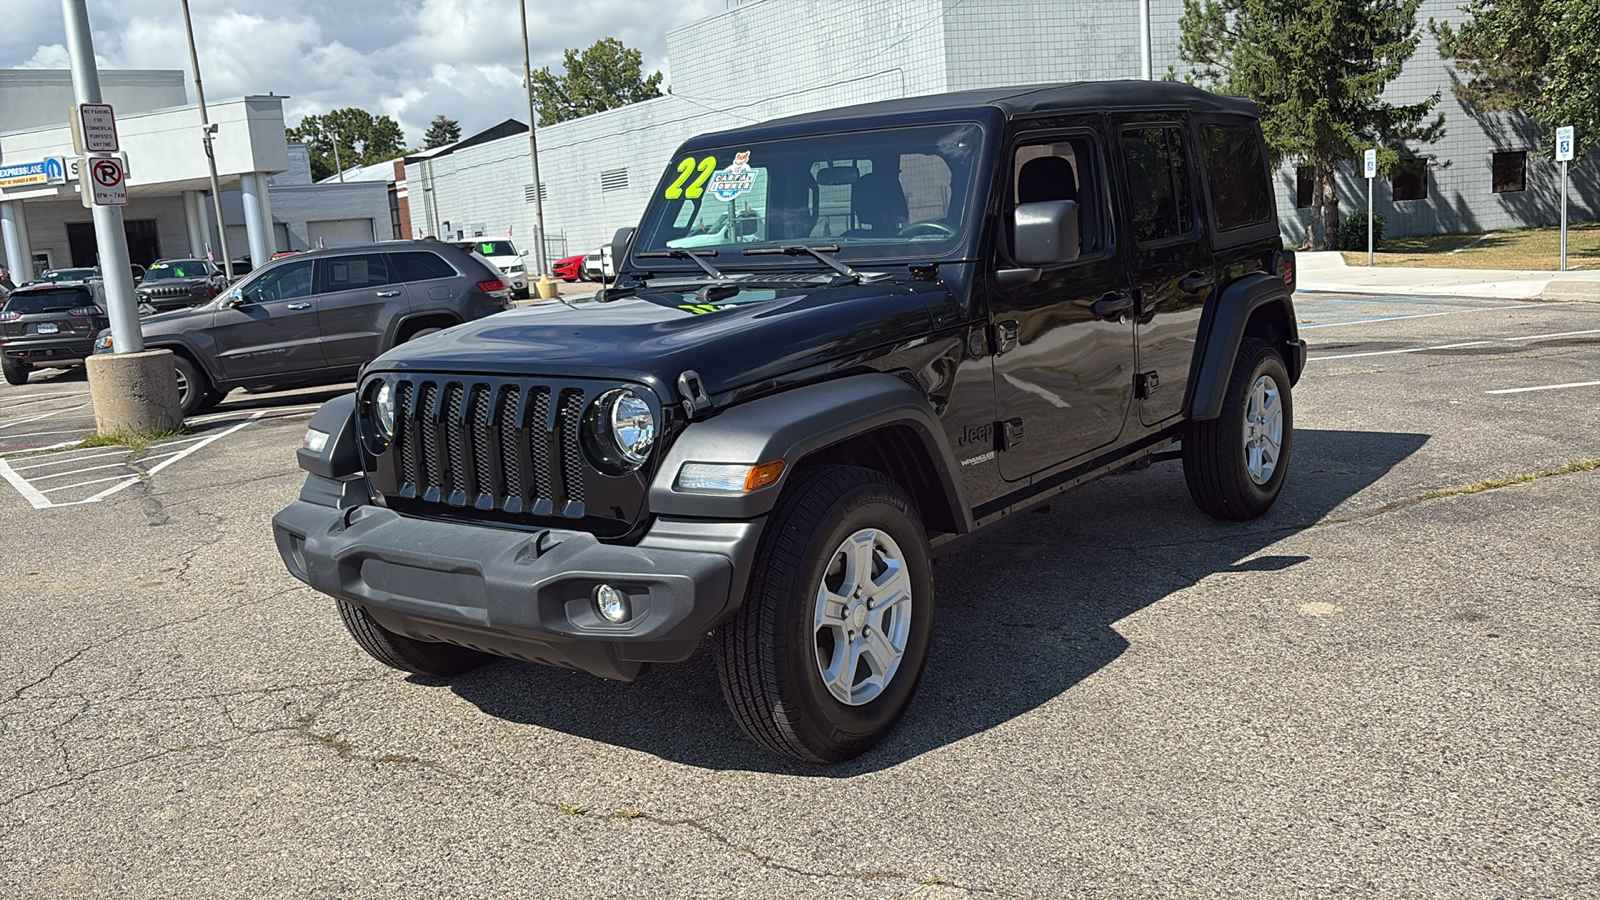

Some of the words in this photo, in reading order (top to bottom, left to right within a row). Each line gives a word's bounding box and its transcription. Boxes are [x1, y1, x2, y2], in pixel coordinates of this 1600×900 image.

[664, 156, 717, 199] 22
[715, 173, 753, 182] CARFAX
[958, 423, 994, 447] Jeep
[960, 451, 995, 466] WRANGLER
[857, 491, 905, 509] MICHELIN
